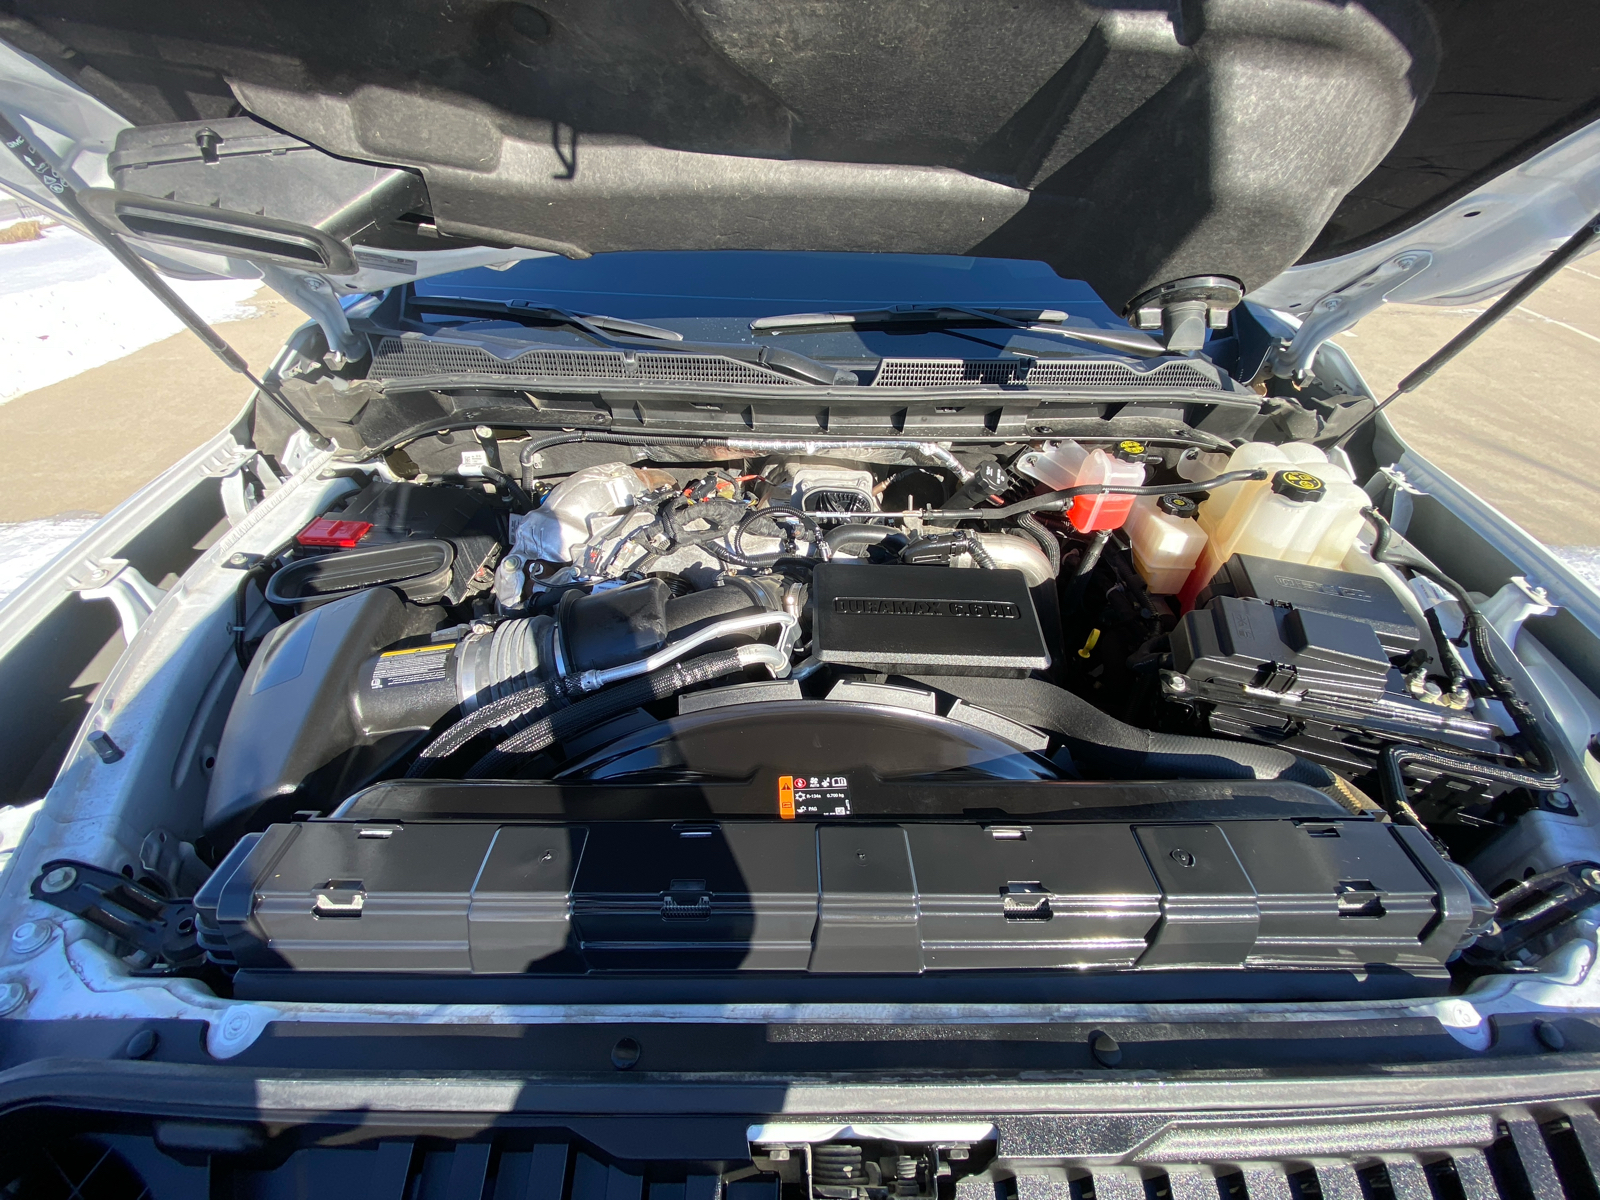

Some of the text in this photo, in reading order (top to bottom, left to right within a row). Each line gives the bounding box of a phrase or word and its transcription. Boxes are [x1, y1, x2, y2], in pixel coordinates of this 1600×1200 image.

[6, 135, 25, 148] GMC
[835, 600, 1016, 619] DURAMAX 6.6 HD
